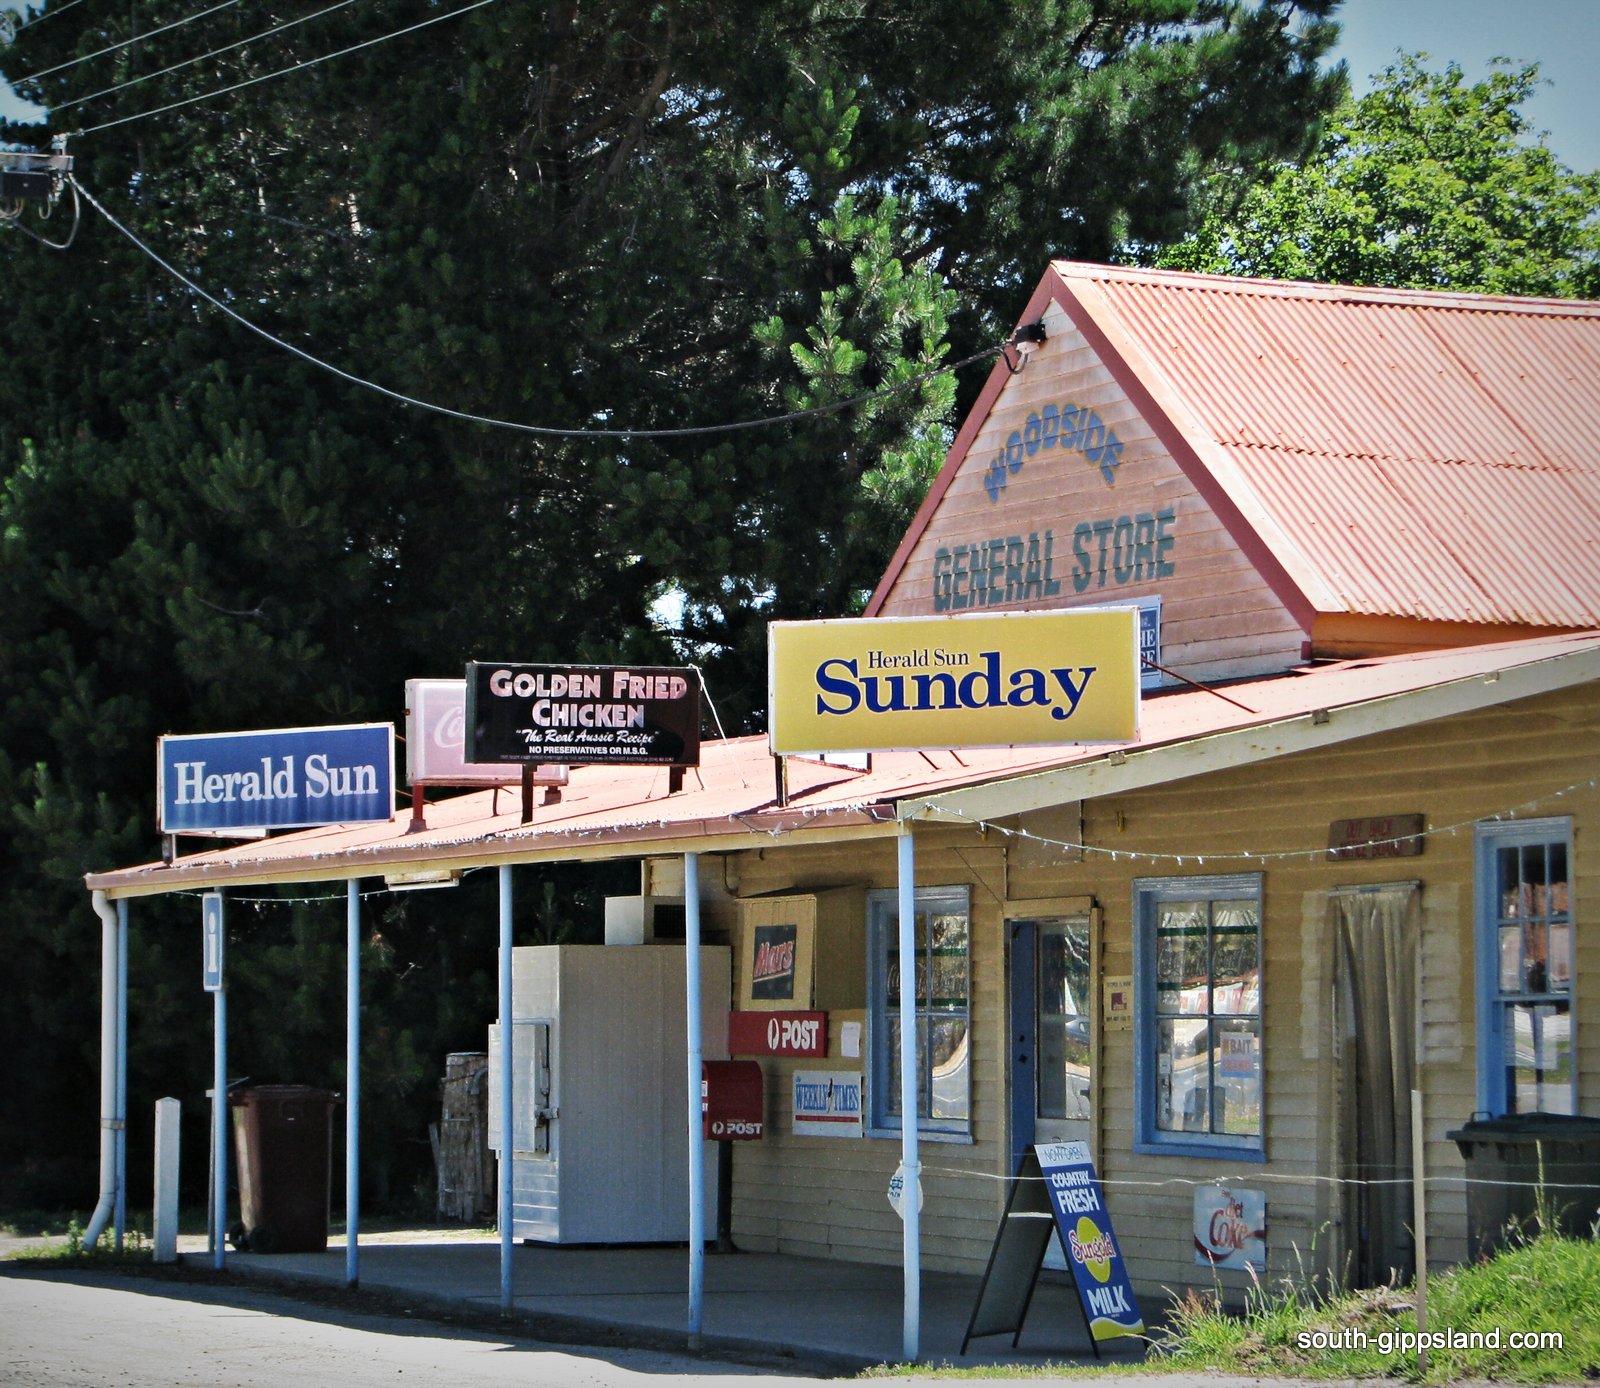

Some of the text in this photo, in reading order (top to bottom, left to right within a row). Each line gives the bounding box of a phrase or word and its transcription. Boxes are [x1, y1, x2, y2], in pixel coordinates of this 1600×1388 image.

[984, 403, 1124, 503] WOODSIDE
[933, 508, 1176, 612] GENERAL STORE
[868, 648, 969, 669] Herald Sun
[490, 669, 687, 699] GOLDEN FRIED
[815, 651, 1097, 720] Sunday
[532, 699, 644, 728] CHICKEN
[529, 746, 648, 755] NO PRESERVATIVES OR M.S.G.
[544, 729, 573, 743] Real
[574, 729, 613, 743] Aussie
[174, 754, 378, 805] Herald Sun
[754, 941, 793, 977] Mars
[782, 1020, 819, 1049] POST
[795, 1084, 859, 1111] WEEKLY TIMES
[727, 1123, 762, 1134] POST
[1052, 1171, 1090, 1188] COUNTRY
[1056, 1188, 1100, 1214] FRESH
[1209, 1209, 1248, 1249] Coke
[1068, 1230, 1116, 1265] Sungold
[1087, 1285, 1131, 1316] MILK
